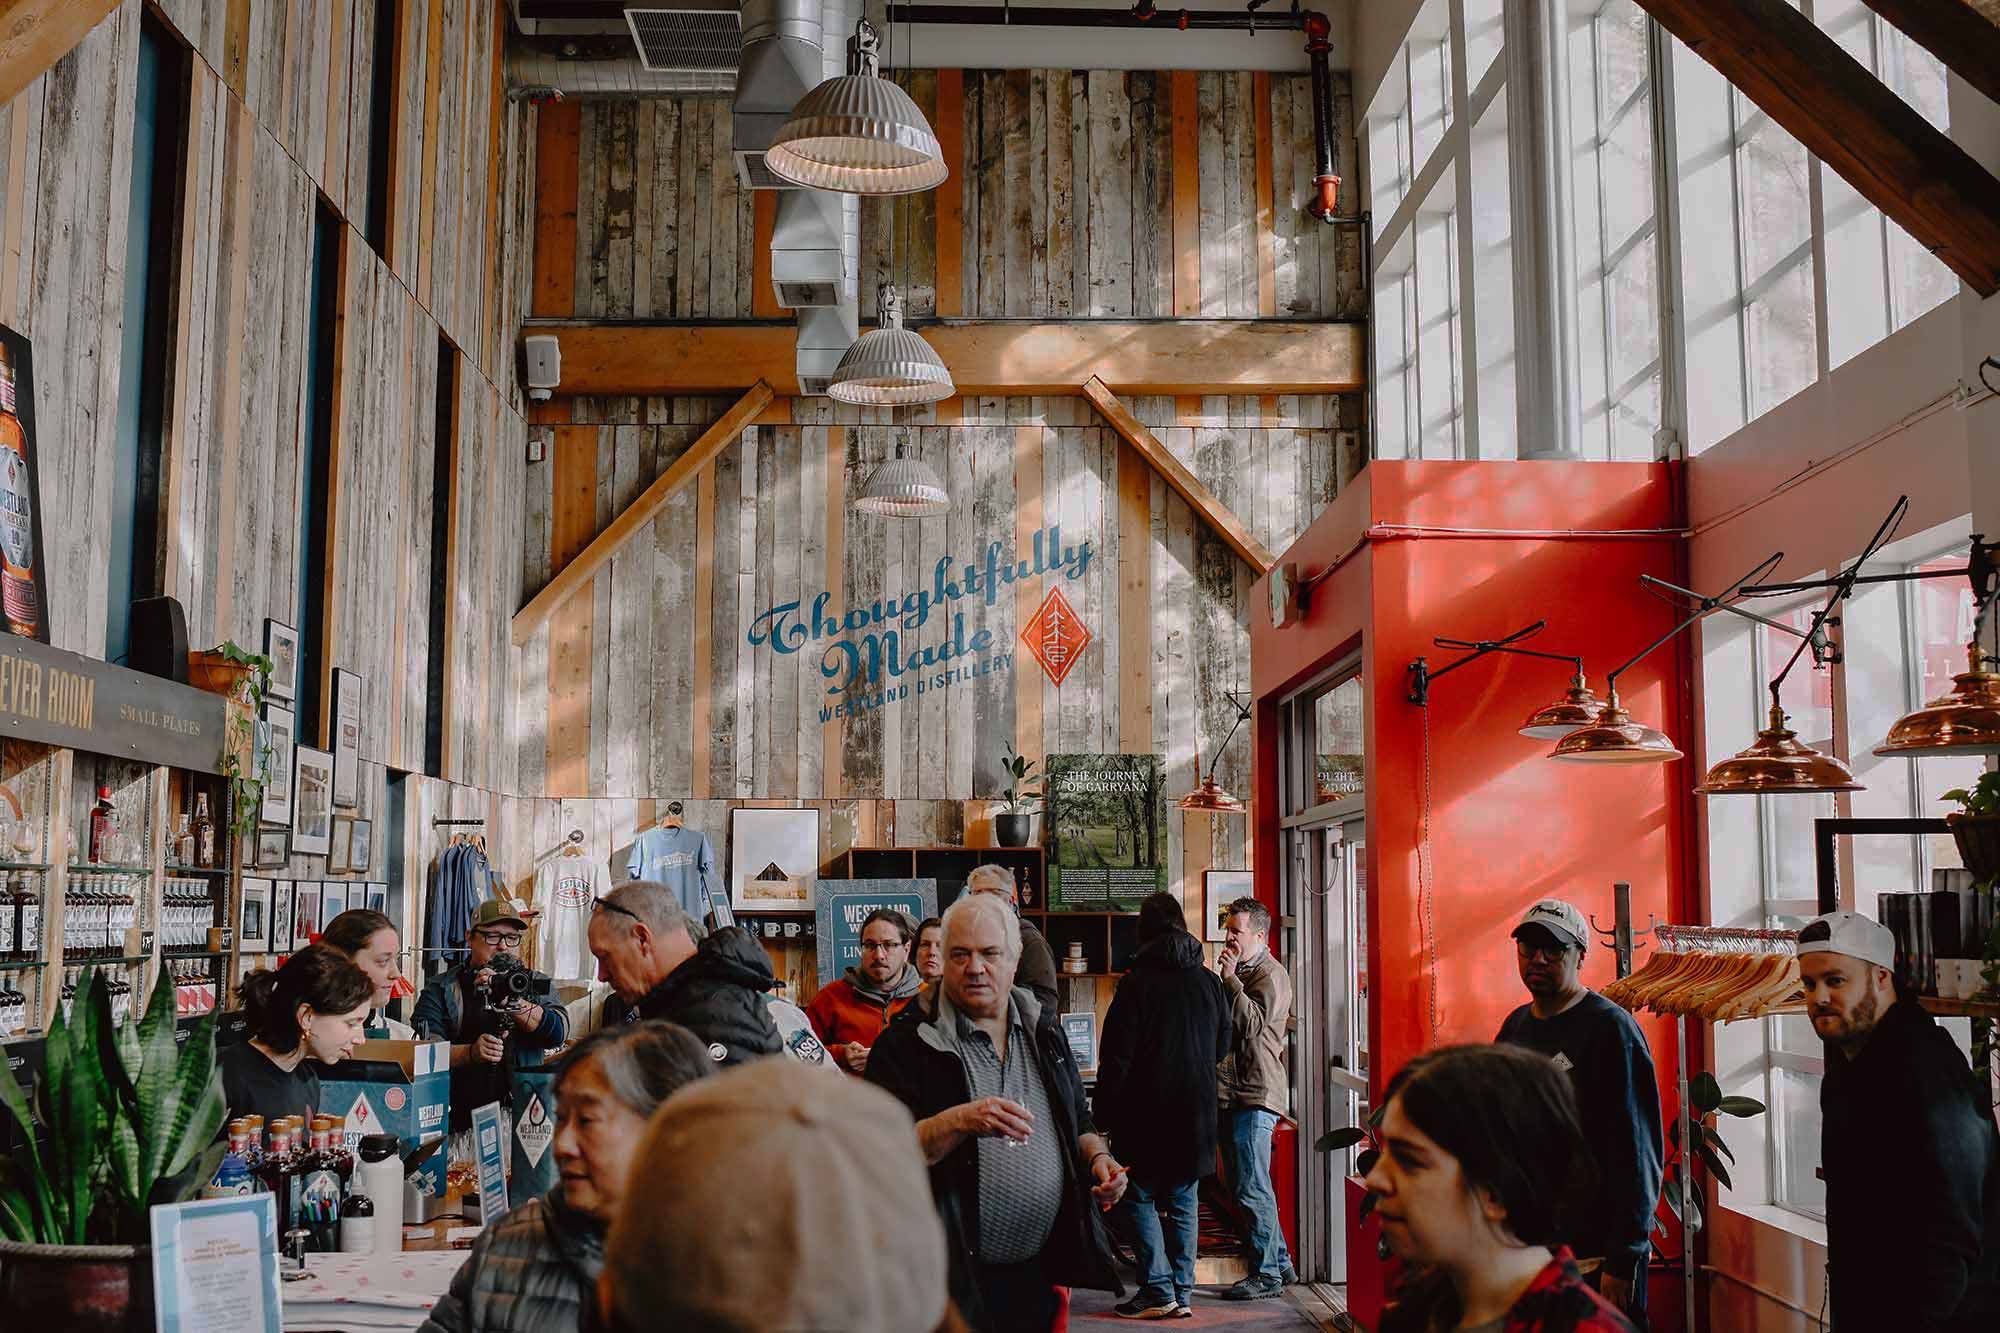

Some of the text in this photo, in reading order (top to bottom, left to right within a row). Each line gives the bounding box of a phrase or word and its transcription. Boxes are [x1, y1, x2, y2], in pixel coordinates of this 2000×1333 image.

[747, 525, 1094, 654] Thoughtfully
[821, 613, 995, 695] Made
[47, 668, 96, 730] ROOM
[119, 703, 201, 737] SMALL PLATES
[818, 654, 1012, 724] WESTLAND DISTILLERY
[1067, 771, 1147, 782] THE JOURNEY
[1067, 782, 1148, 792] OF GARRYANA
